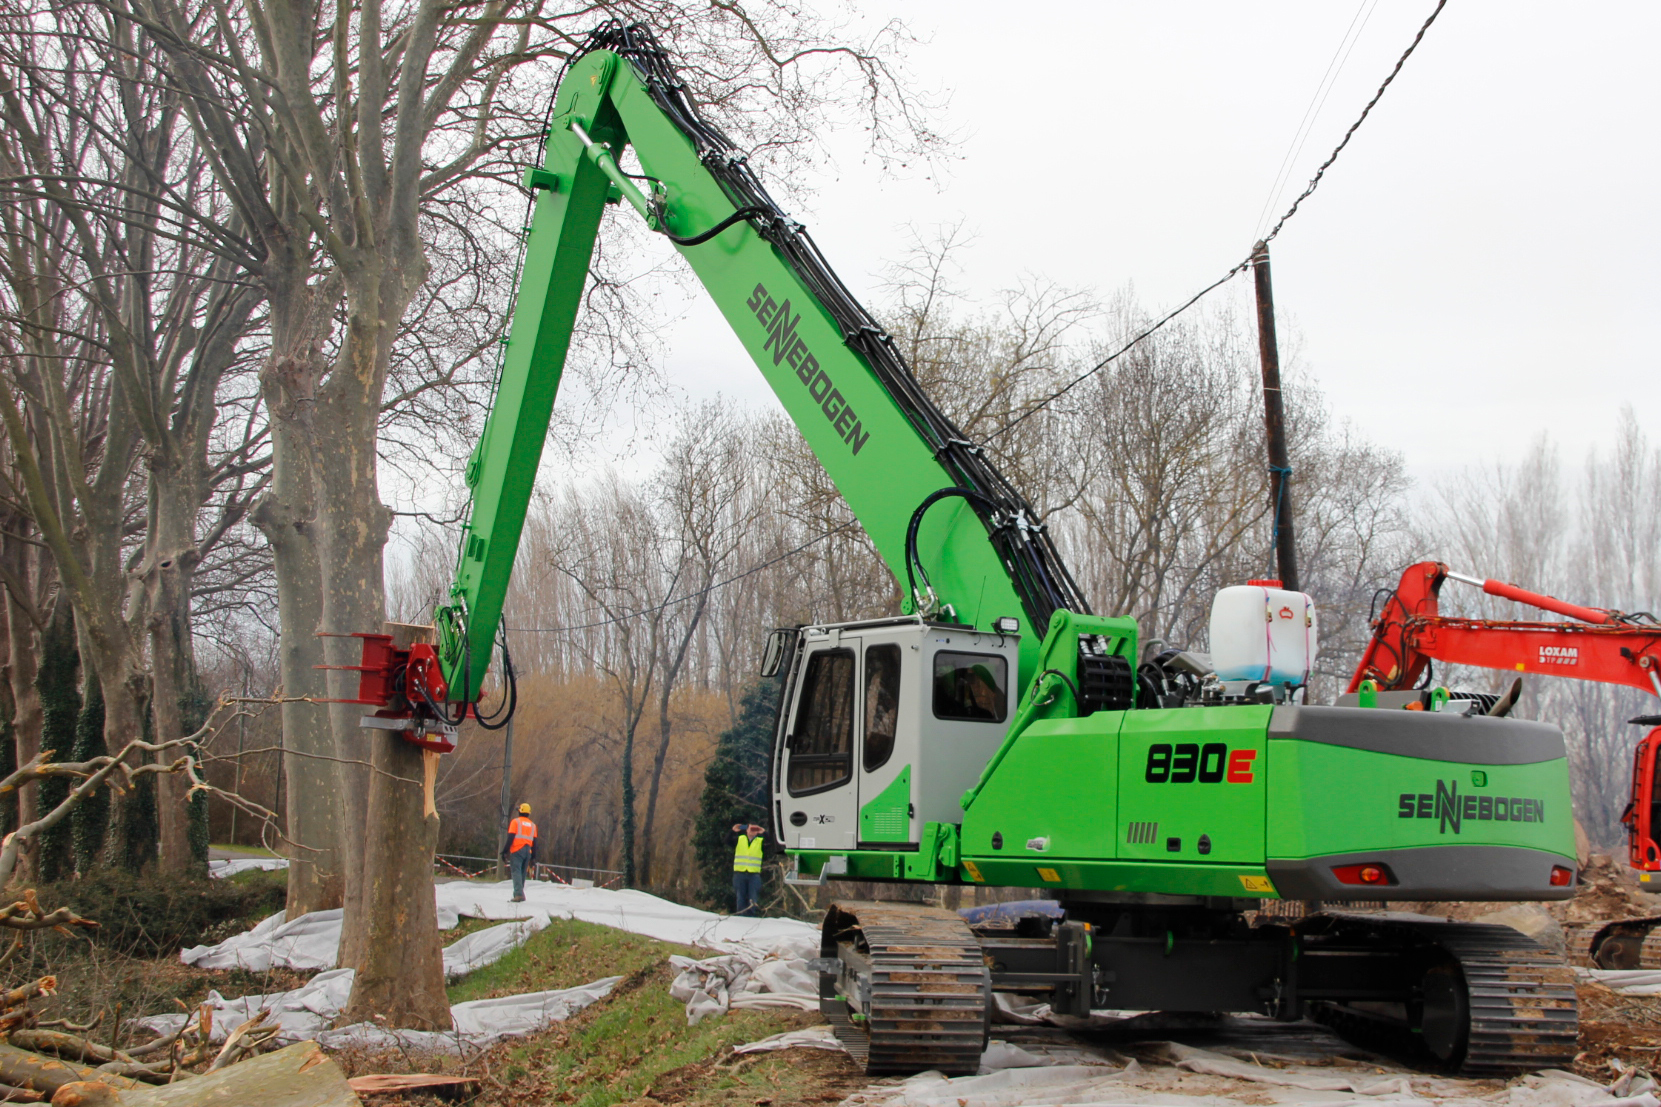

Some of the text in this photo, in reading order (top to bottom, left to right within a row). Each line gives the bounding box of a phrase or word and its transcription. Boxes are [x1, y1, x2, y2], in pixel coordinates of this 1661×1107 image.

[746, 282, 870, 456] SENNEBOGEN
[1539, 646, 1578, 657] LOXAM
[1145, 743, 1257, 783] 830E
[1398, 779, 1544, 834] SENNEBOGEN
